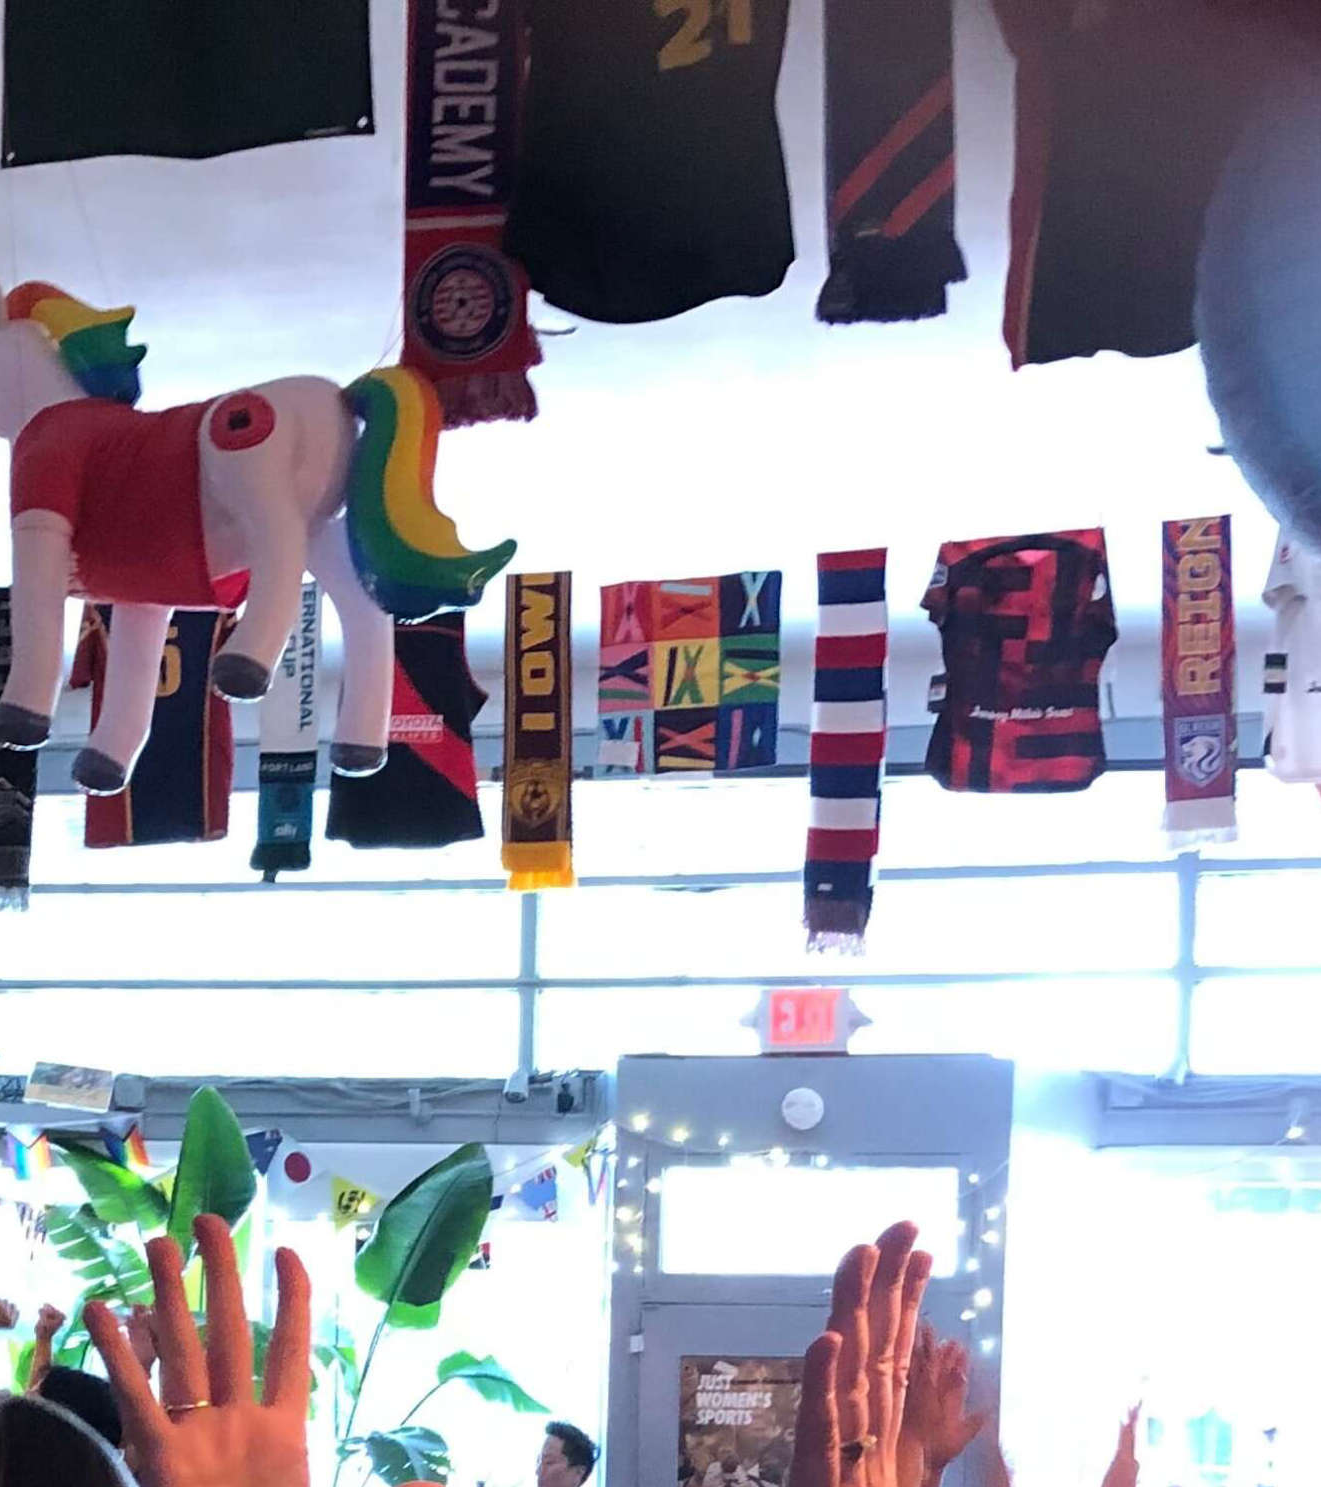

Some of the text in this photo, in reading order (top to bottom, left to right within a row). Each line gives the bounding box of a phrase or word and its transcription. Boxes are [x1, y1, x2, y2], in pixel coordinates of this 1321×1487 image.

[1177, 517, 1222, 696] REIGN
[299, 582, 317, 733] TERNATIONAL
[391, 715, 443, 731] OYOTA
[697, 1374, 735, 1391] JUST
[696, 1391, 773, 1409] WOMEN'S
[695, 1409, 754, 1425] SPORTS
